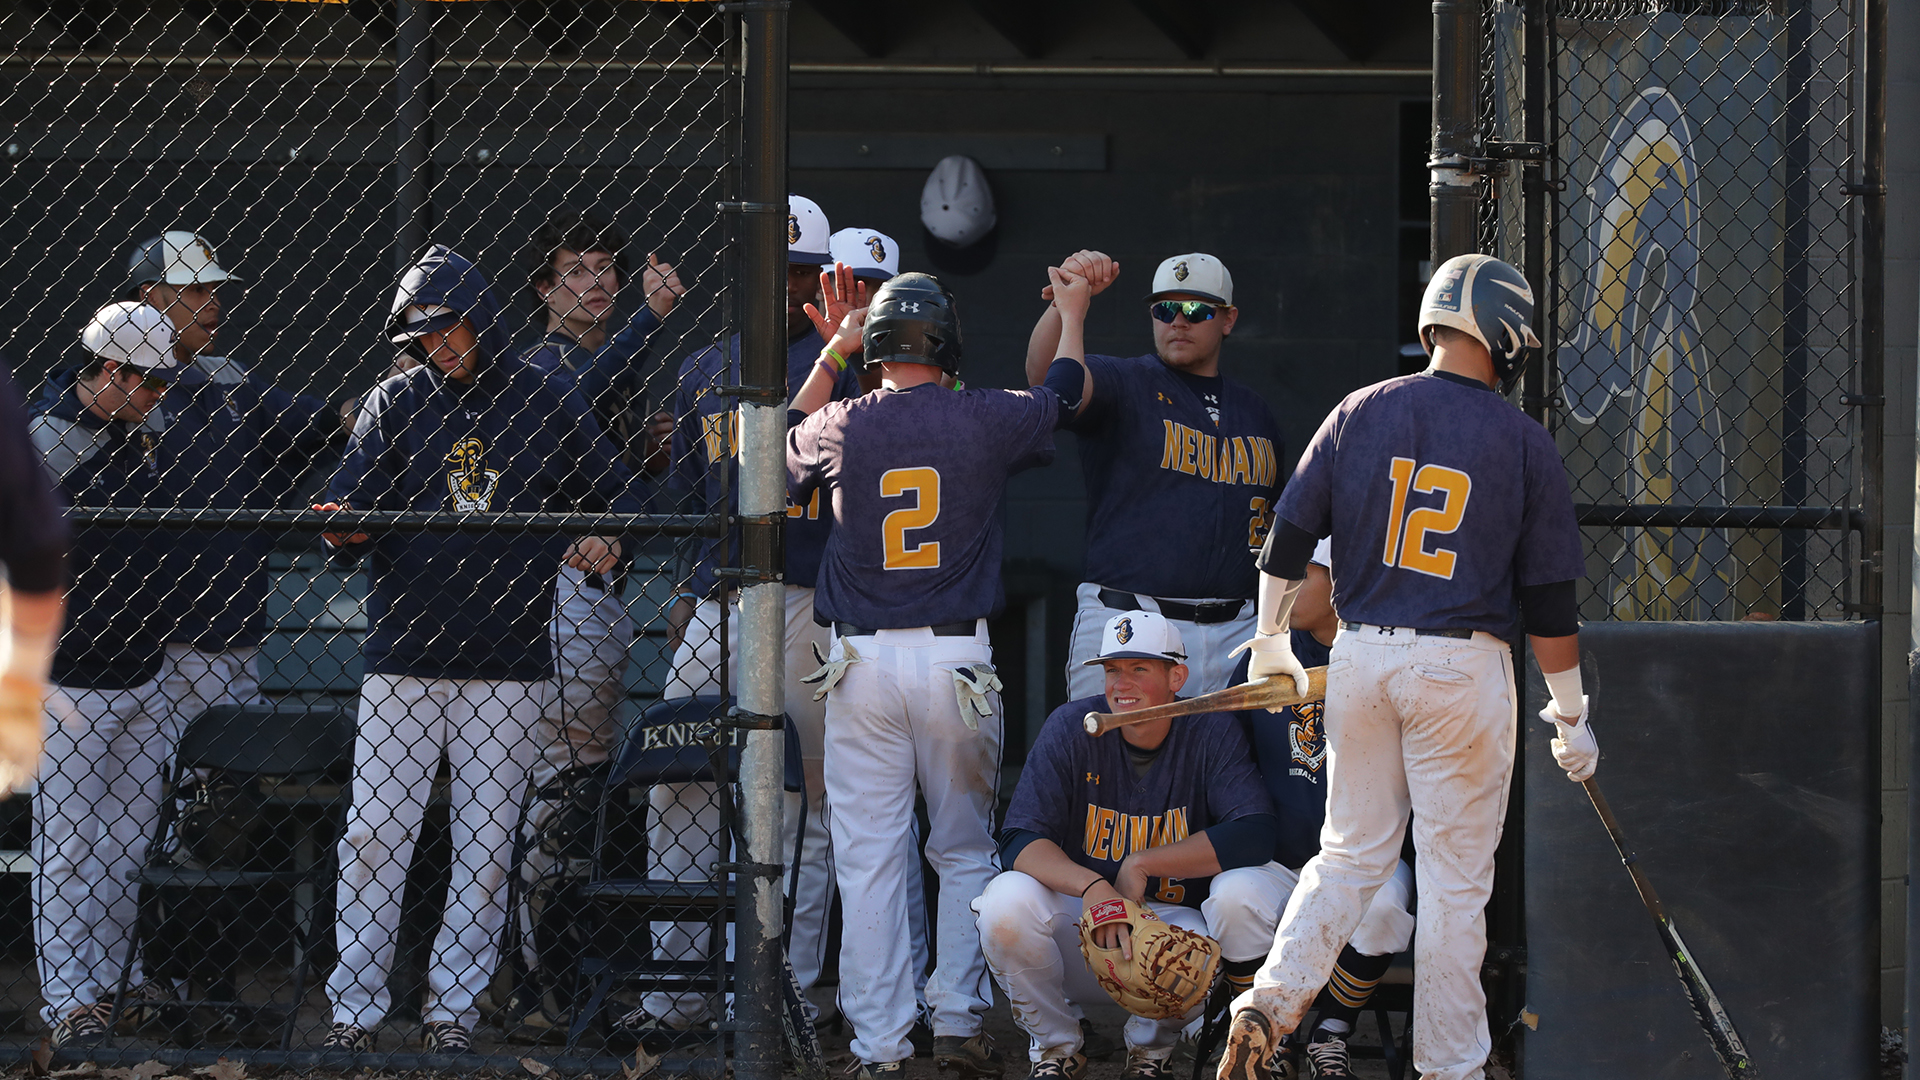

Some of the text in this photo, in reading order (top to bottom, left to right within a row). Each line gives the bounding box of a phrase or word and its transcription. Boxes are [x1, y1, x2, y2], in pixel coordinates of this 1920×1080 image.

[1160, 419, 1277, 488] NEUMANN
[879, 465, 941, 571] 2
[1382, 456, 1472, 581] 12
